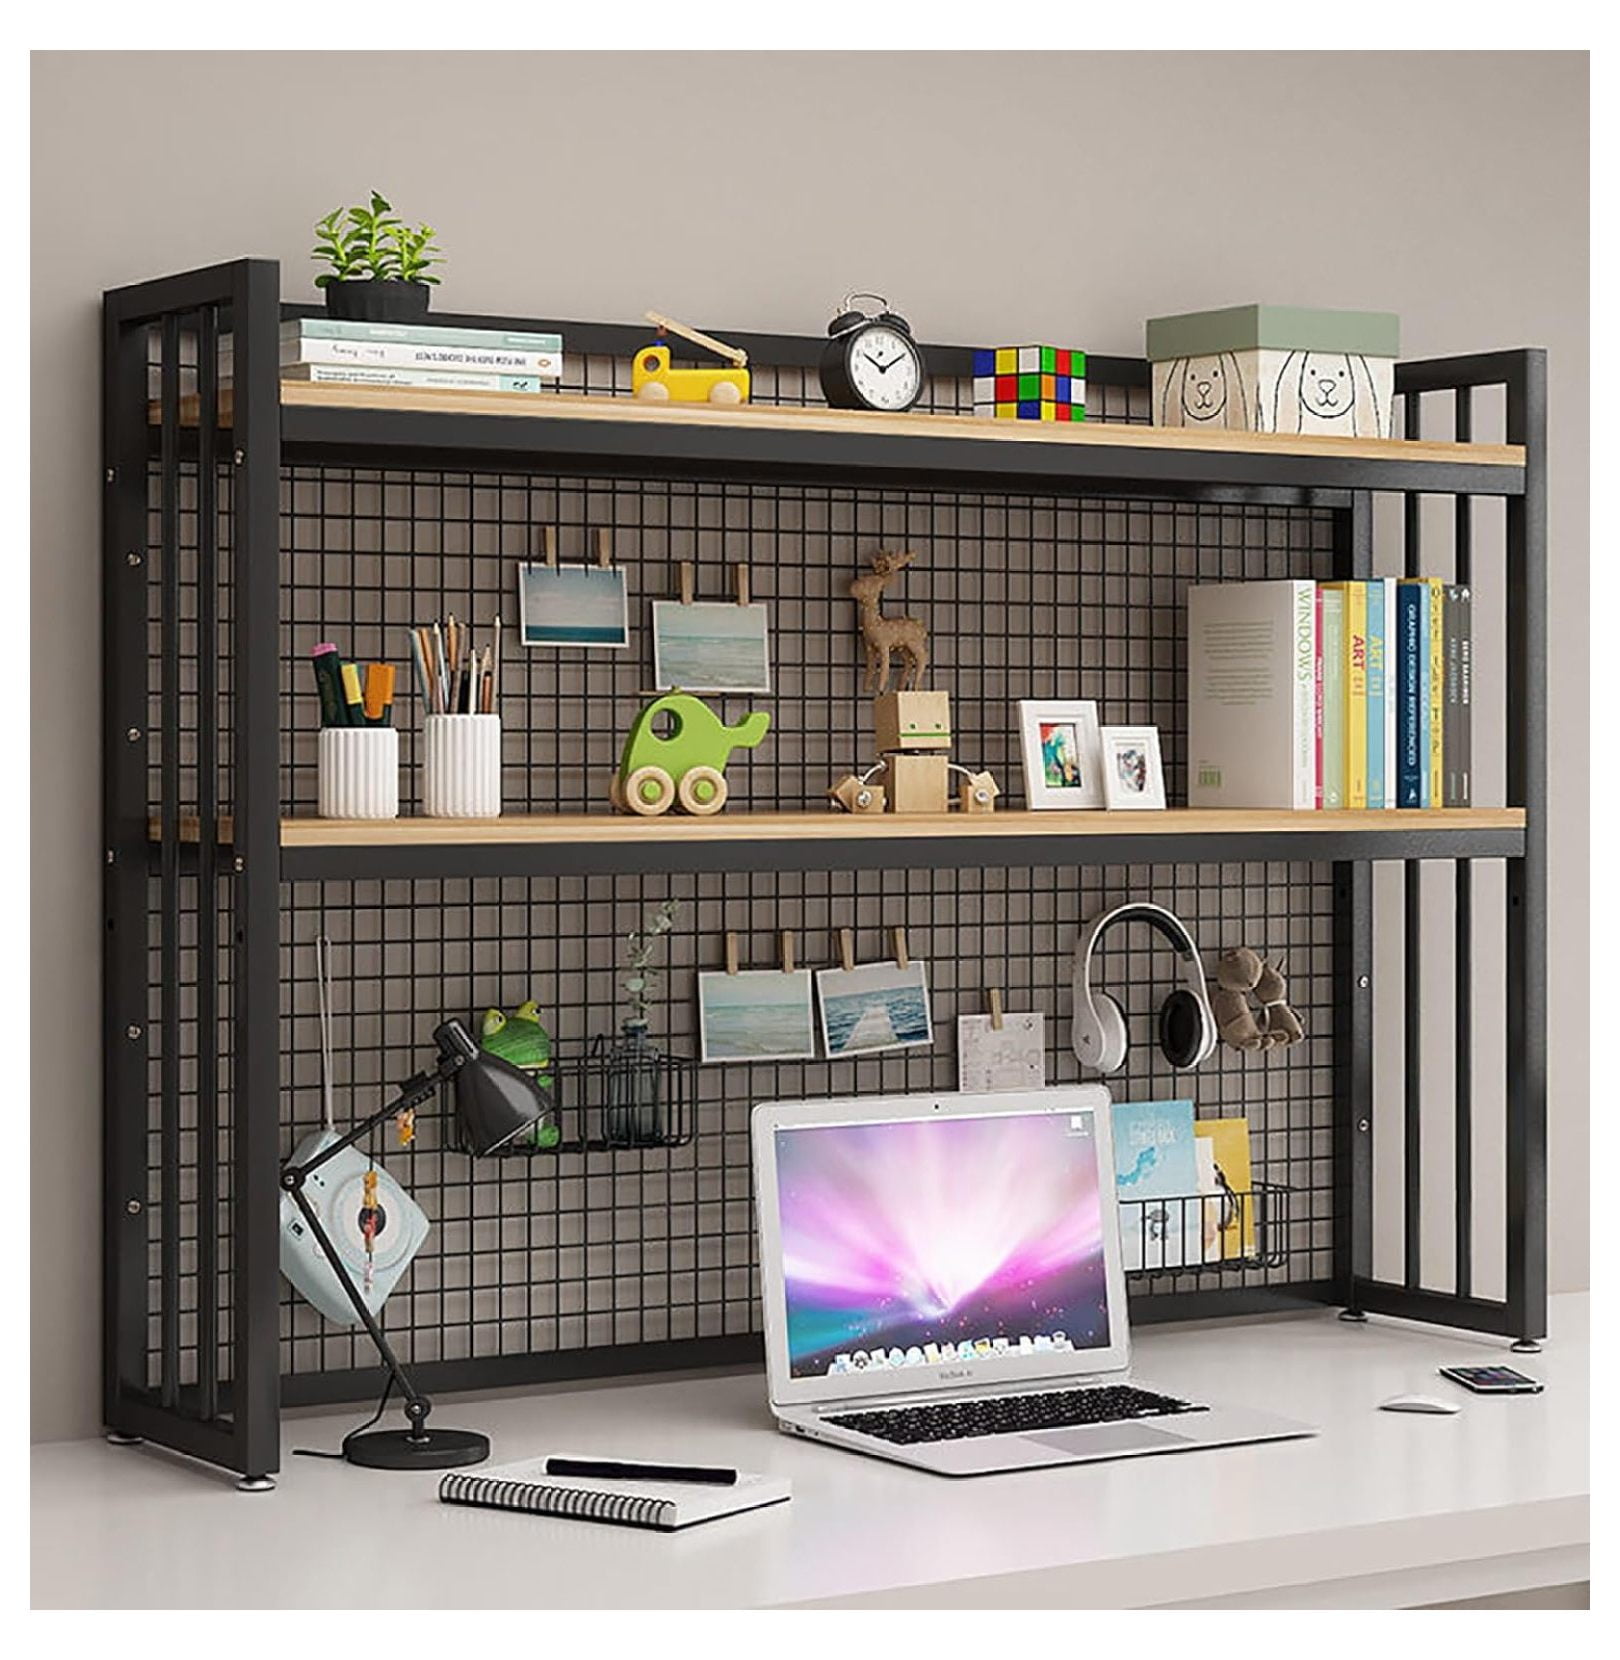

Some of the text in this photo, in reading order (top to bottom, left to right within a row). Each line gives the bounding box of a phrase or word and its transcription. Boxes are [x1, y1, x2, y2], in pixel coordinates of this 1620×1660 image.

[1297, 588, 1312, 681] WINDOWS
[1352, 635, 1365, 671] ART
[1369, 635, 1384, 671] ART
[1407, 604, 1417, 766] GRAPHIC DESIGN REFERENCED
